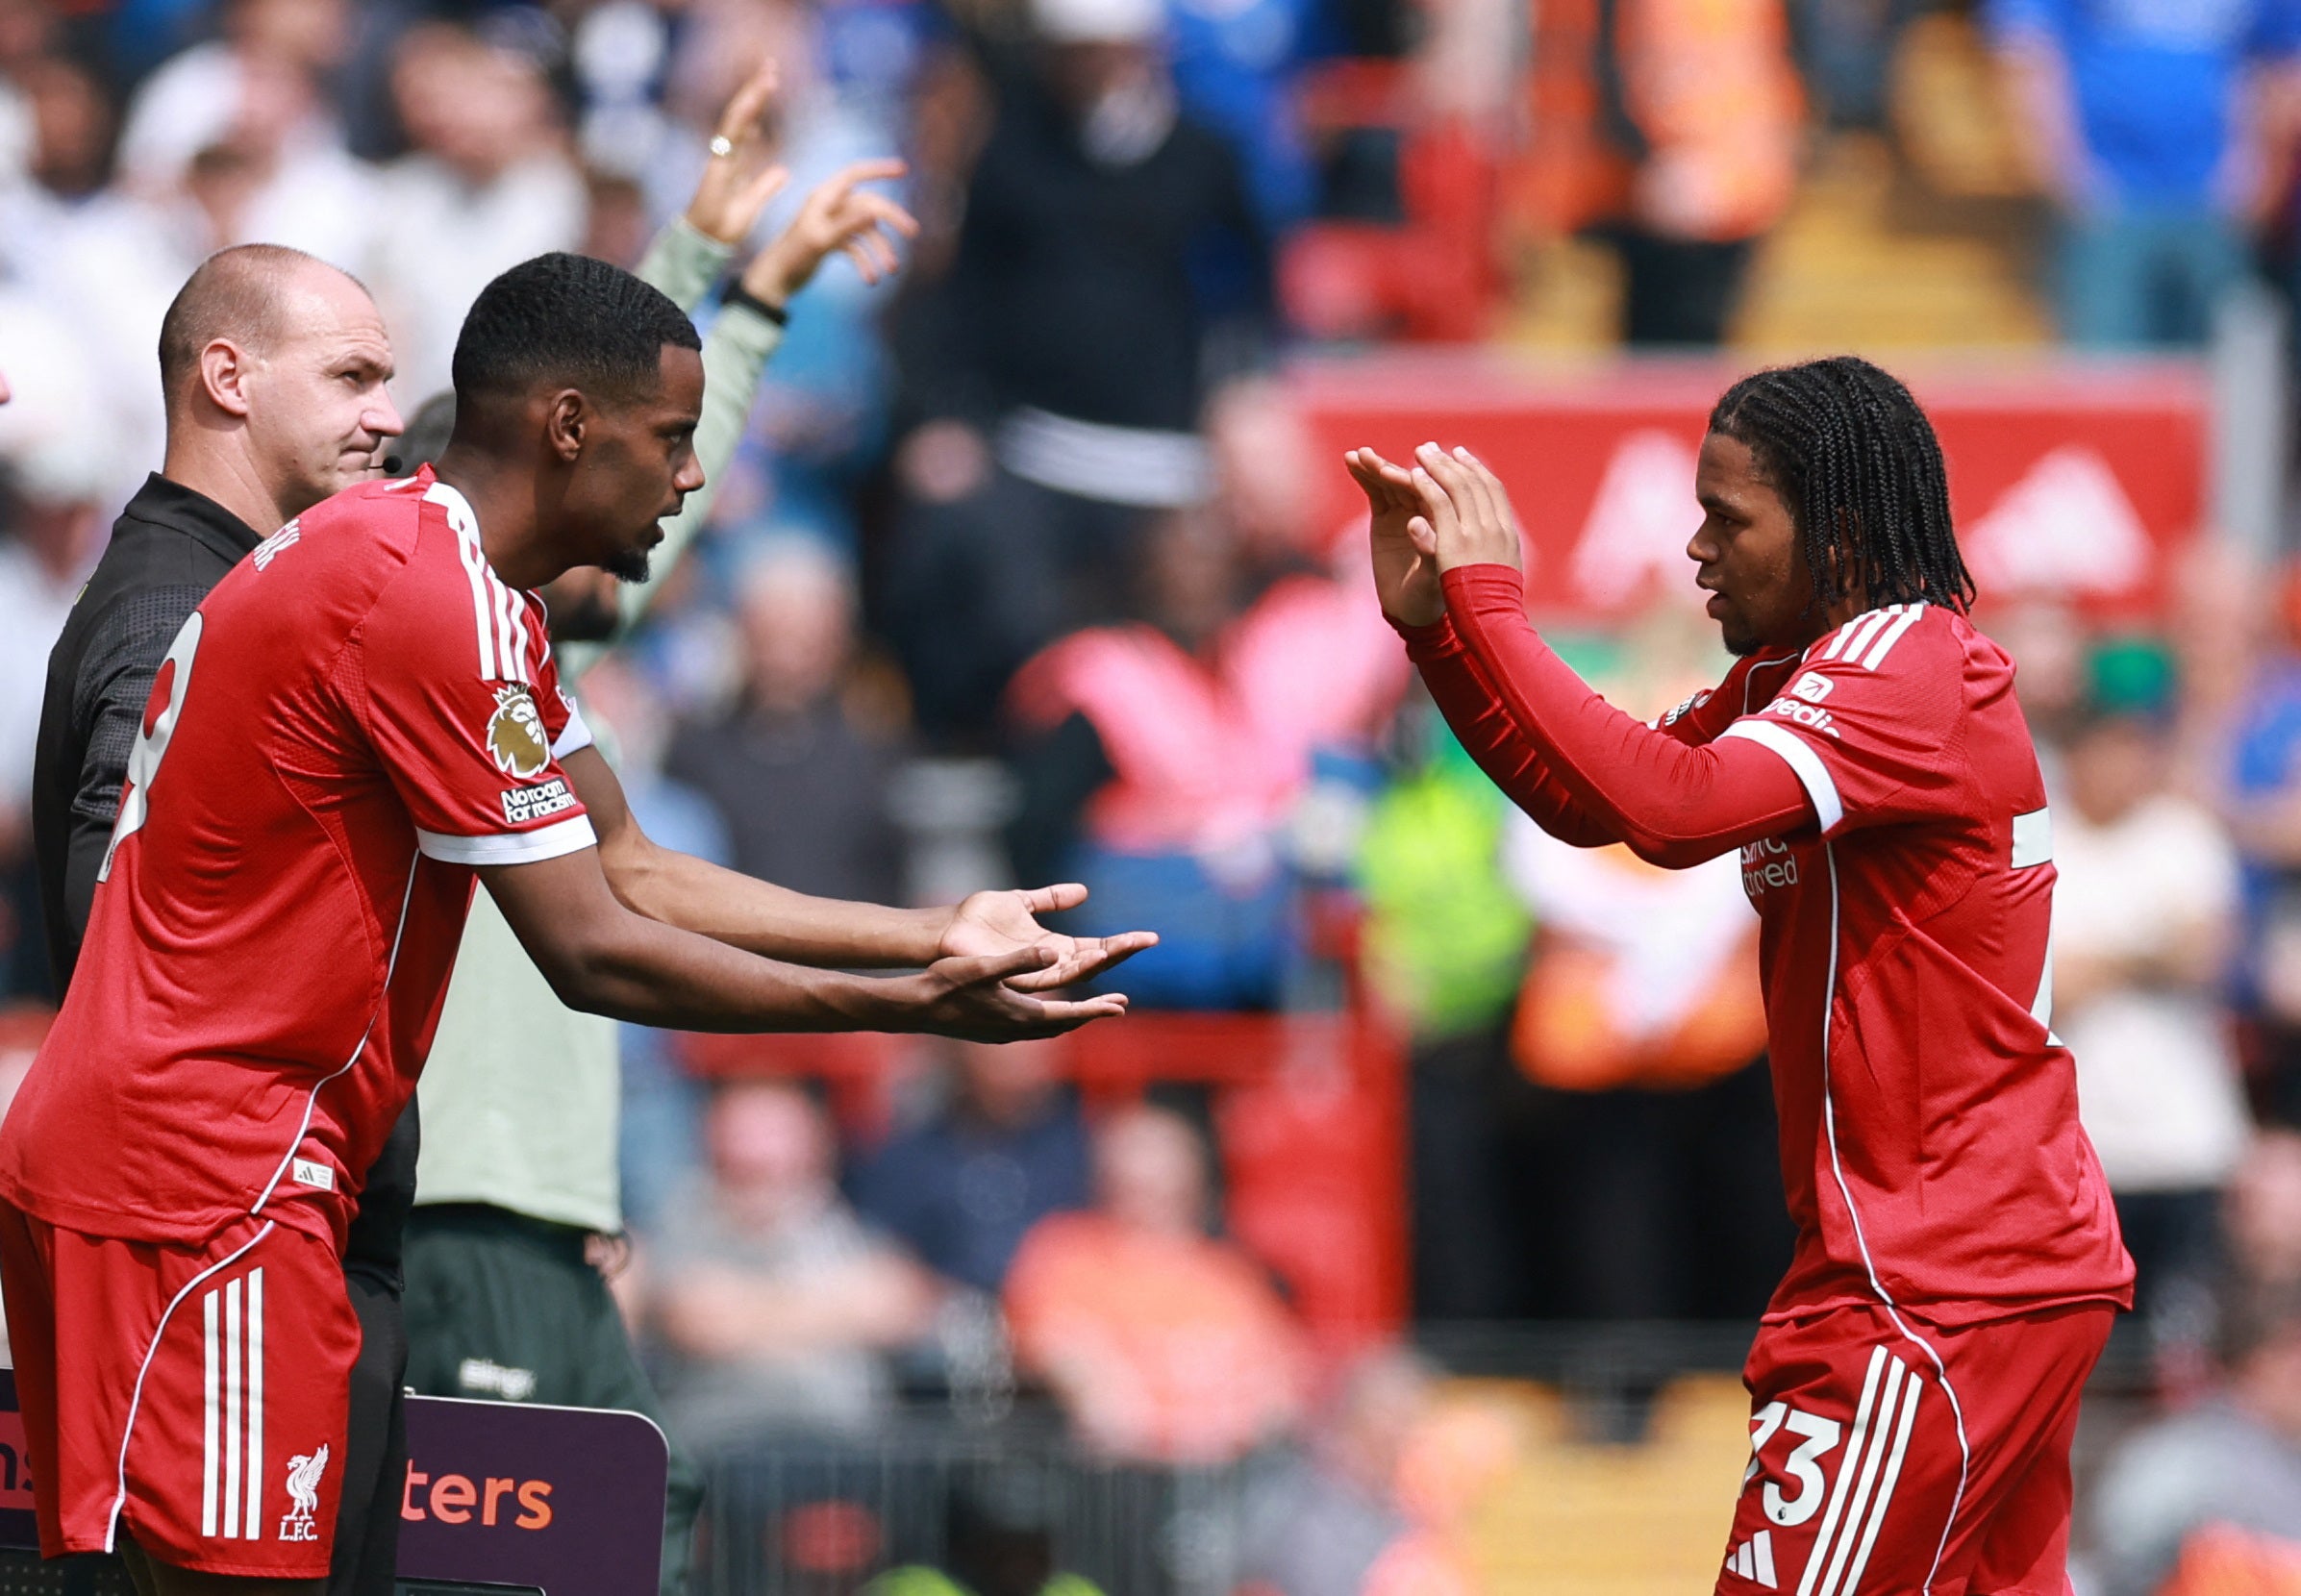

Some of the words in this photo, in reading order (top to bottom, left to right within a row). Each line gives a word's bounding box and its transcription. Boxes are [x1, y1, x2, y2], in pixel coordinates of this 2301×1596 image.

[501, 789, 529, 808] No
[526, 780, 566, 803] room
[505, 805, 531, 824] for
[532, 792, 577, 817] racism
[1739, 1401, 1841, 1527] 73
[400, 1459, 553, 1530] ters
[278, 1521, 318, 1541] L.F.C.
